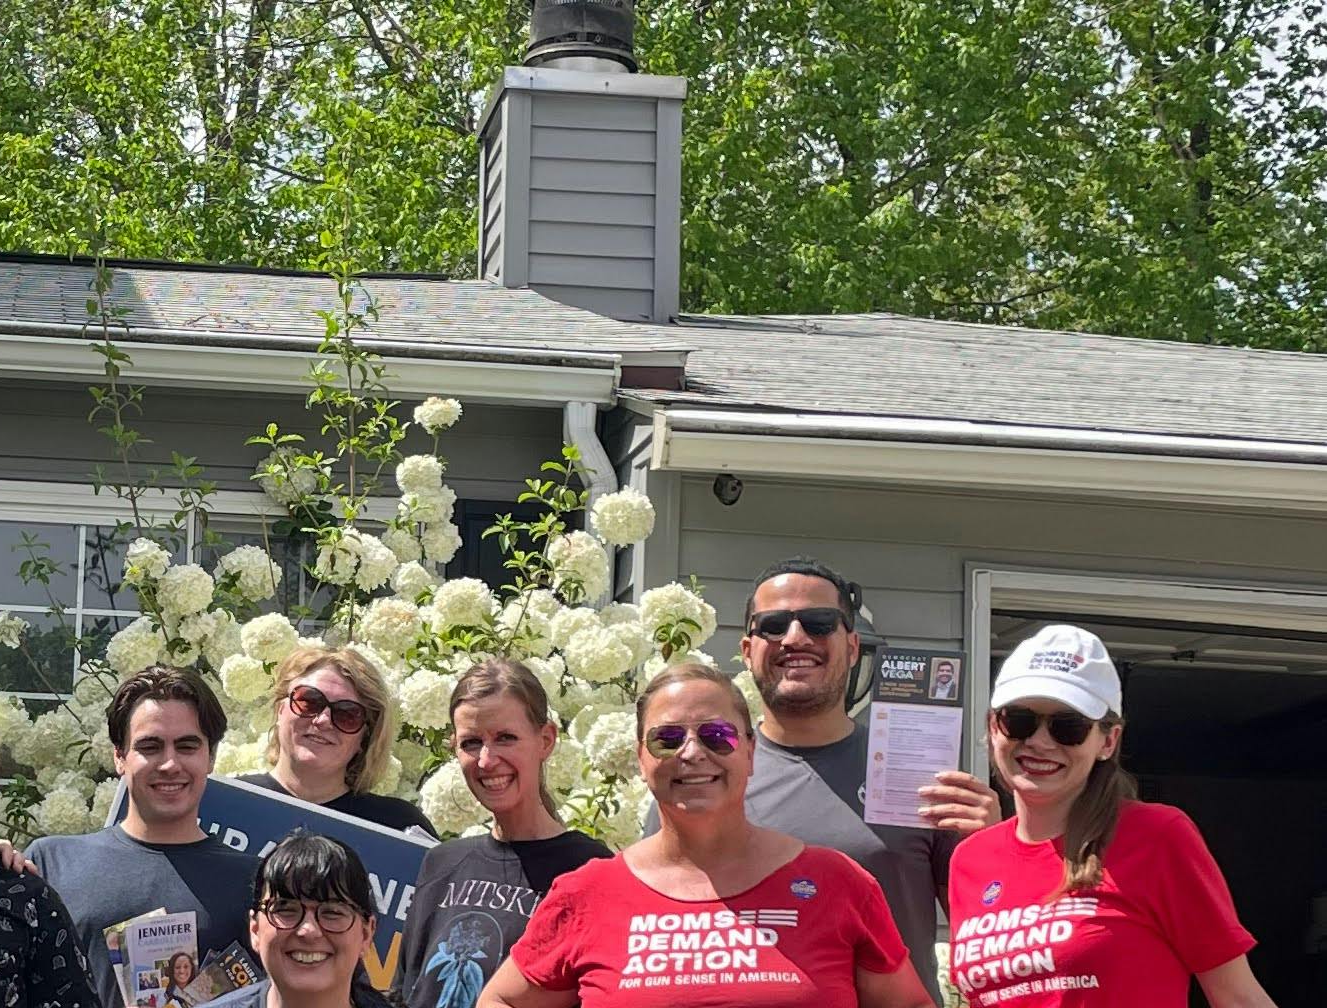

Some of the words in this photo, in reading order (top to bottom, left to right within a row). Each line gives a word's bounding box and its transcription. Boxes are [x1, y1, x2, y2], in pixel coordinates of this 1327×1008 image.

[881, 660, 926, 672] ALBERT
[881, 670, 914, 680] VEGA
[138, 923, 191, 940] JENNIFER
[629, 910, 736, 932] MOMS
[956, 905, 1041, 941] MOMS
[627, 927, 779, 953] DEMAND
[954, 920, 1073, 967] DEMAND
[622, 948, 757, 975] ACTION
[956, 948, 1056, 994] ACTION
[619, 978, 641, 989] FOR
[644, 976, 670, 986] GUN
[674, 973, 716, 985] SENSE
[720, 972, 734, 984] IN
[738, 972, 801, 984] AMERICA
[1000, 982, 1032, 1001] SENSE
[1032, 980, 1045, 994] IN
[1045, 975, 1099, 992] AMERICA
